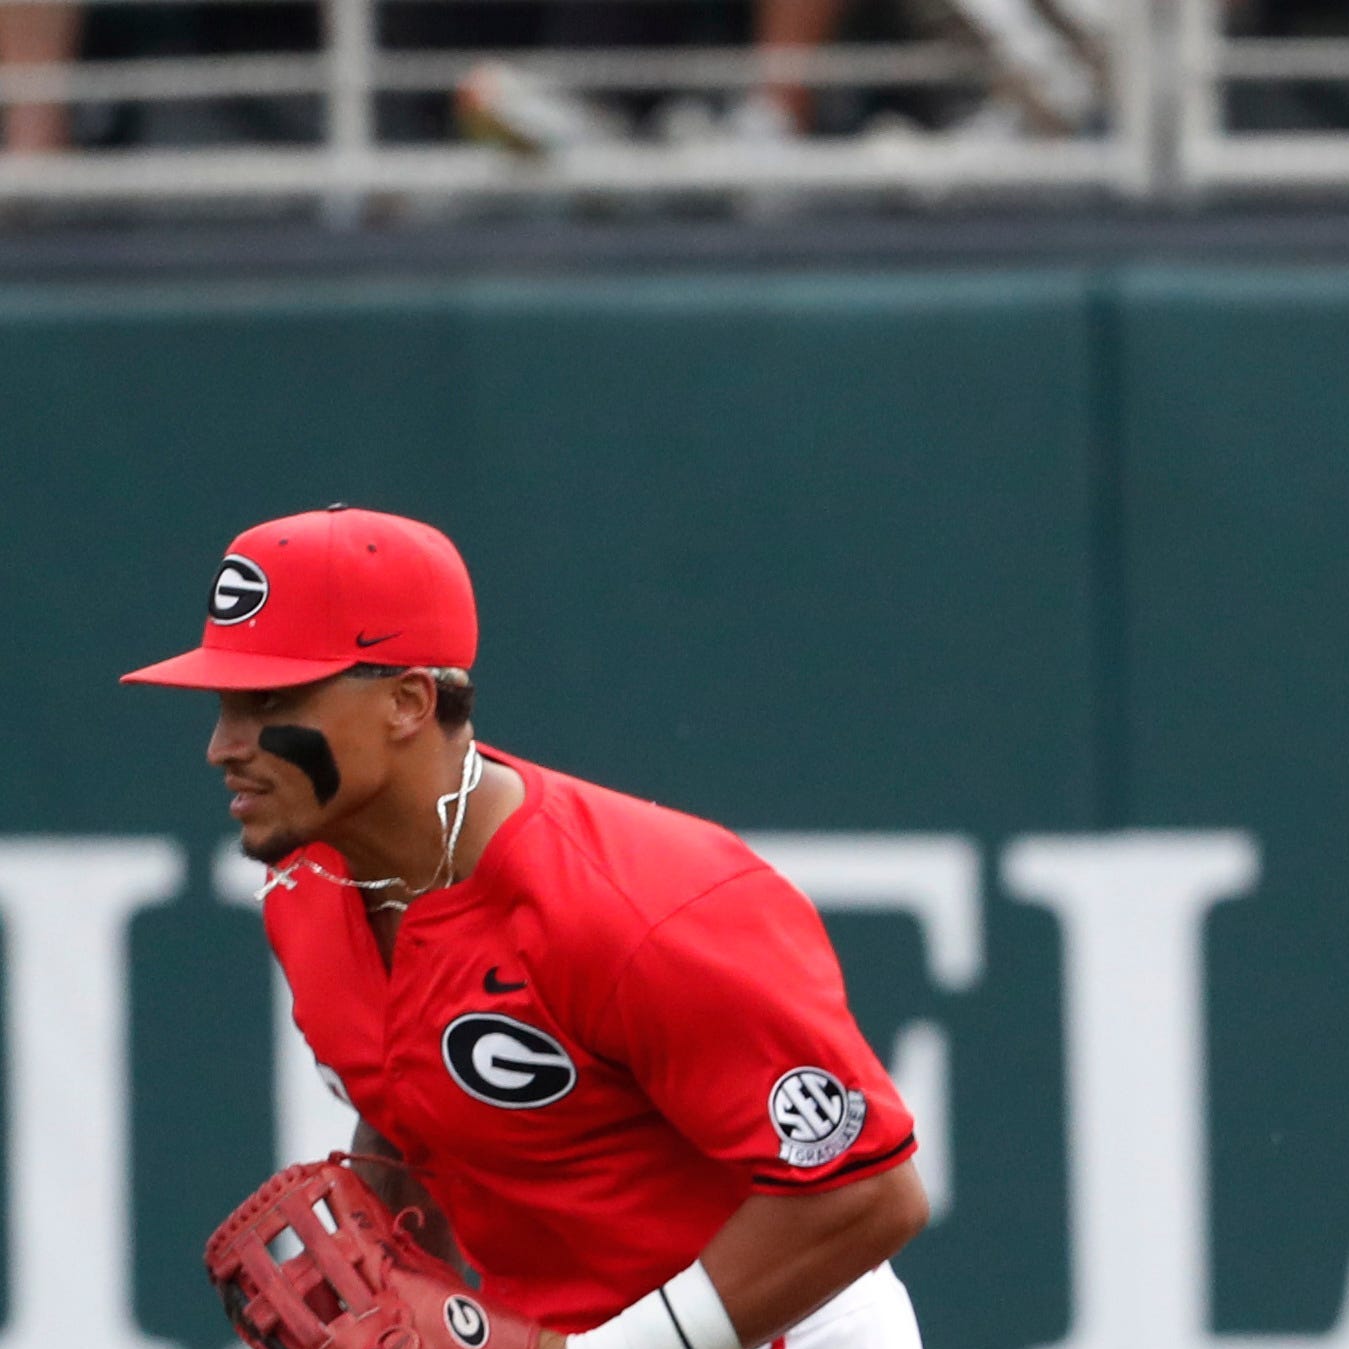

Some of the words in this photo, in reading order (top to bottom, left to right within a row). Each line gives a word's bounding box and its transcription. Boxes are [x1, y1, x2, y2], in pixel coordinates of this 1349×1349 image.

[209, 554, 269, 626] G
[442, 1012, 577, 1109] G
[773, 1070, 844, 1142] SEC
